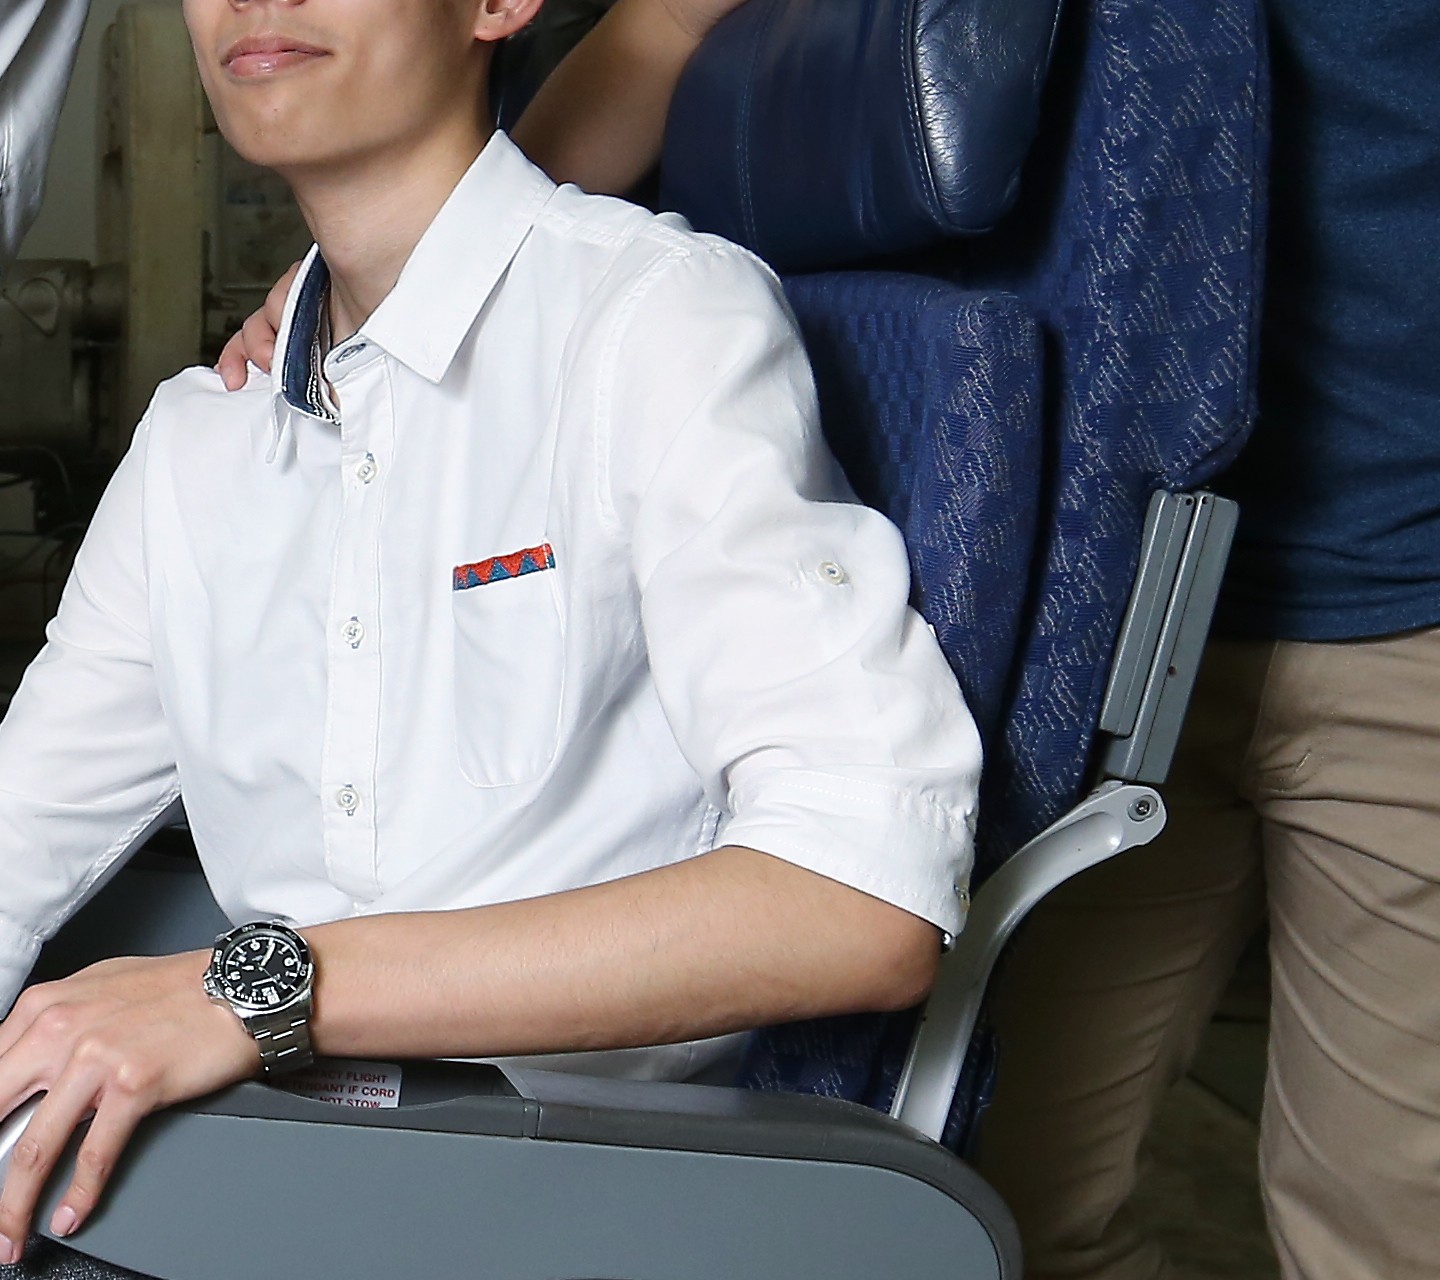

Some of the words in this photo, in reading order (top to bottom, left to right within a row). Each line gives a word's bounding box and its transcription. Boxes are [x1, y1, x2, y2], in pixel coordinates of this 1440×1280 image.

[346, 1071, 388, 1084] FLIGHT
[348, 1085, 358, 1095] IF
[361, 1086, 396, 1099] CORD
